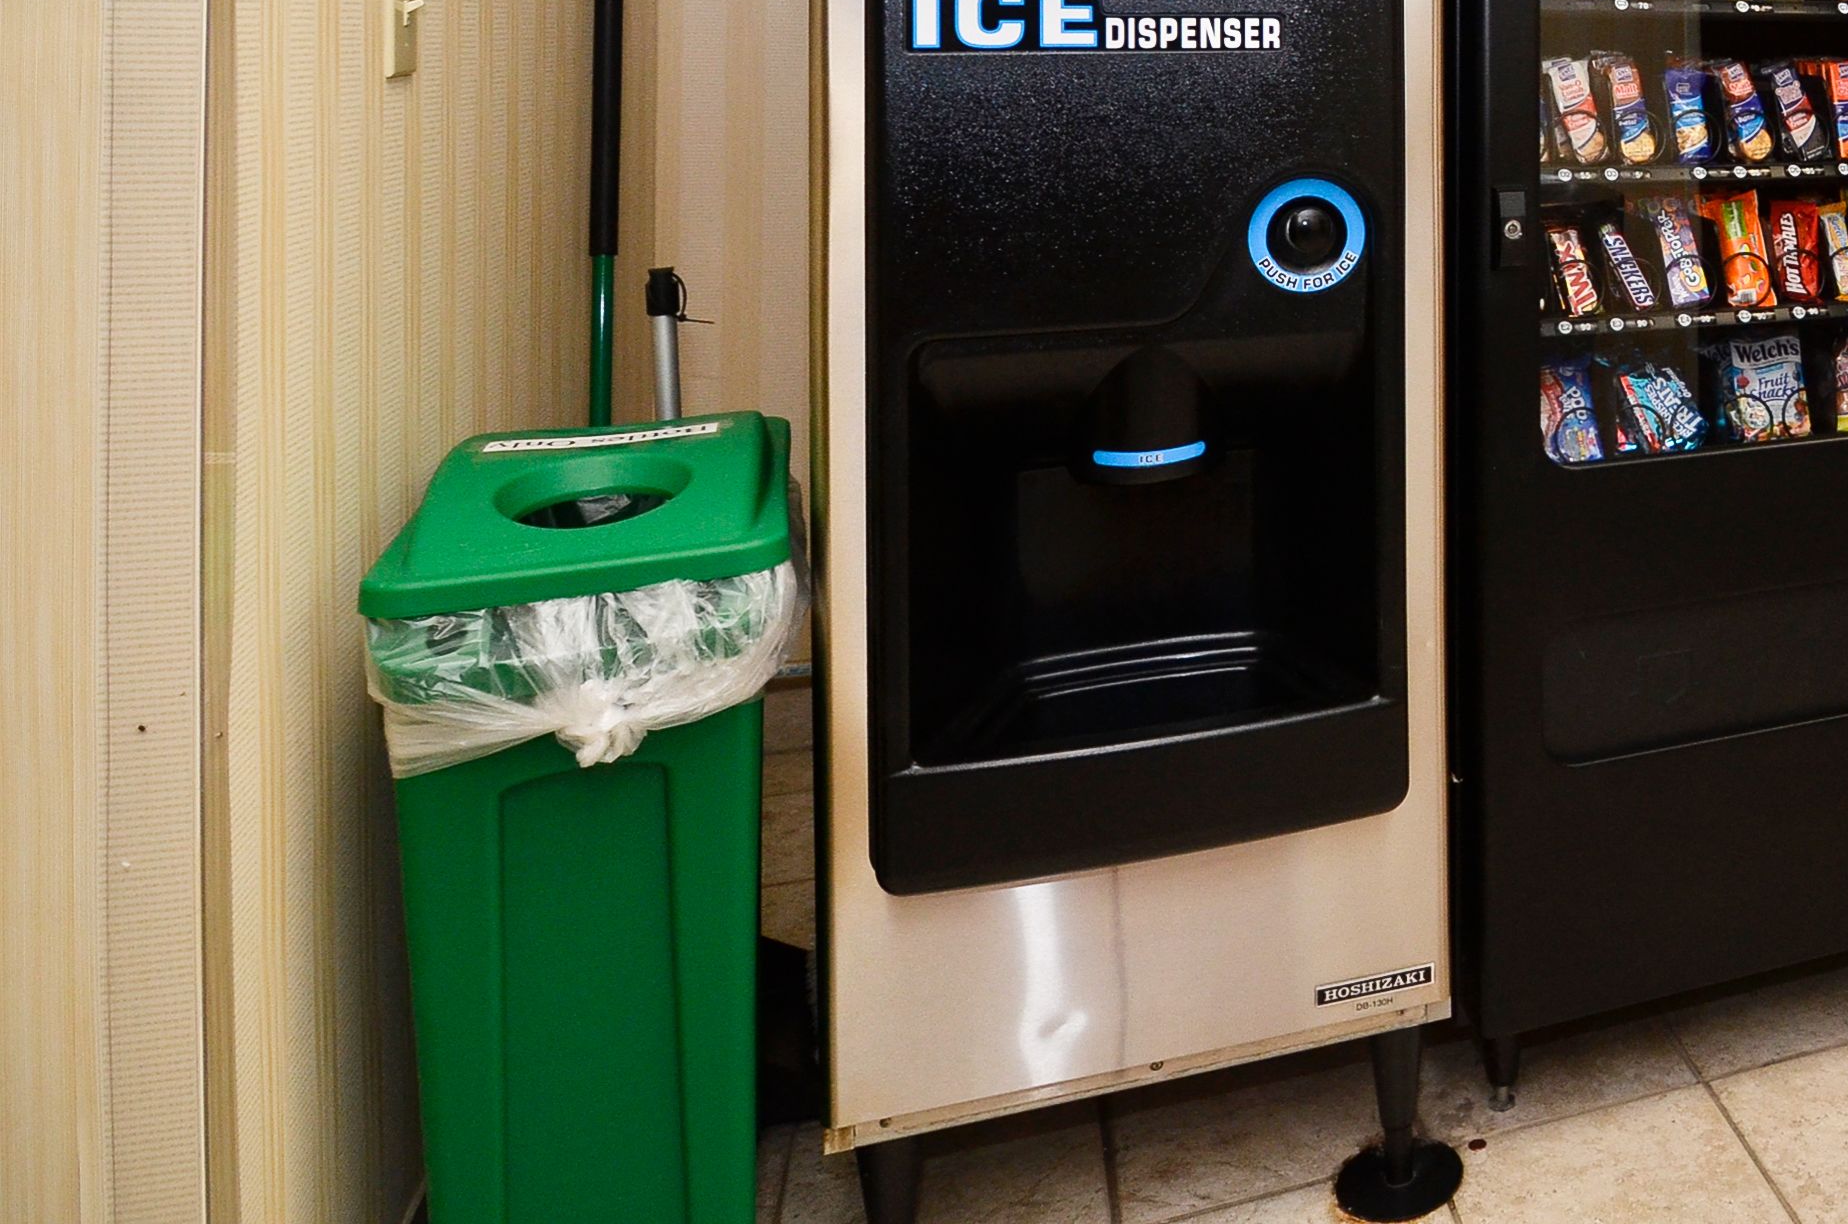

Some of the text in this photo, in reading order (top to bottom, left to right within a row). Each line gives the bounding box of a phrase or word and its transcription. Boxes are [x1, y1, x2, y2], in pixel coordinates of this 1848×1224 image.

[1104, 16, 1282, 50] DISPENSER
[1258, 251, 1358, 290] PUSH FOR ICE
[1557, 241, 1598, 315] TWIX
[1603, 234, 1656, 306] SNICKERS
[1784, 266, 1808, 294] HOT
[1732, 339, 1800, 364] Welch's
[1750, 383, 1799, 401] Snacks
[1757, 372, 1791, 391] Fruit
[1643, 383, 1673, 426] KRISPIES
[1672, 420, 1694, 439] RICE
[488, 438, 577, 450] Only
[1139, 454, 1163, 464] ICE
[1323, 969, 1427, 1002] HOSHIZAKI
[1355, 997, 1394, 1012] DB-130H
